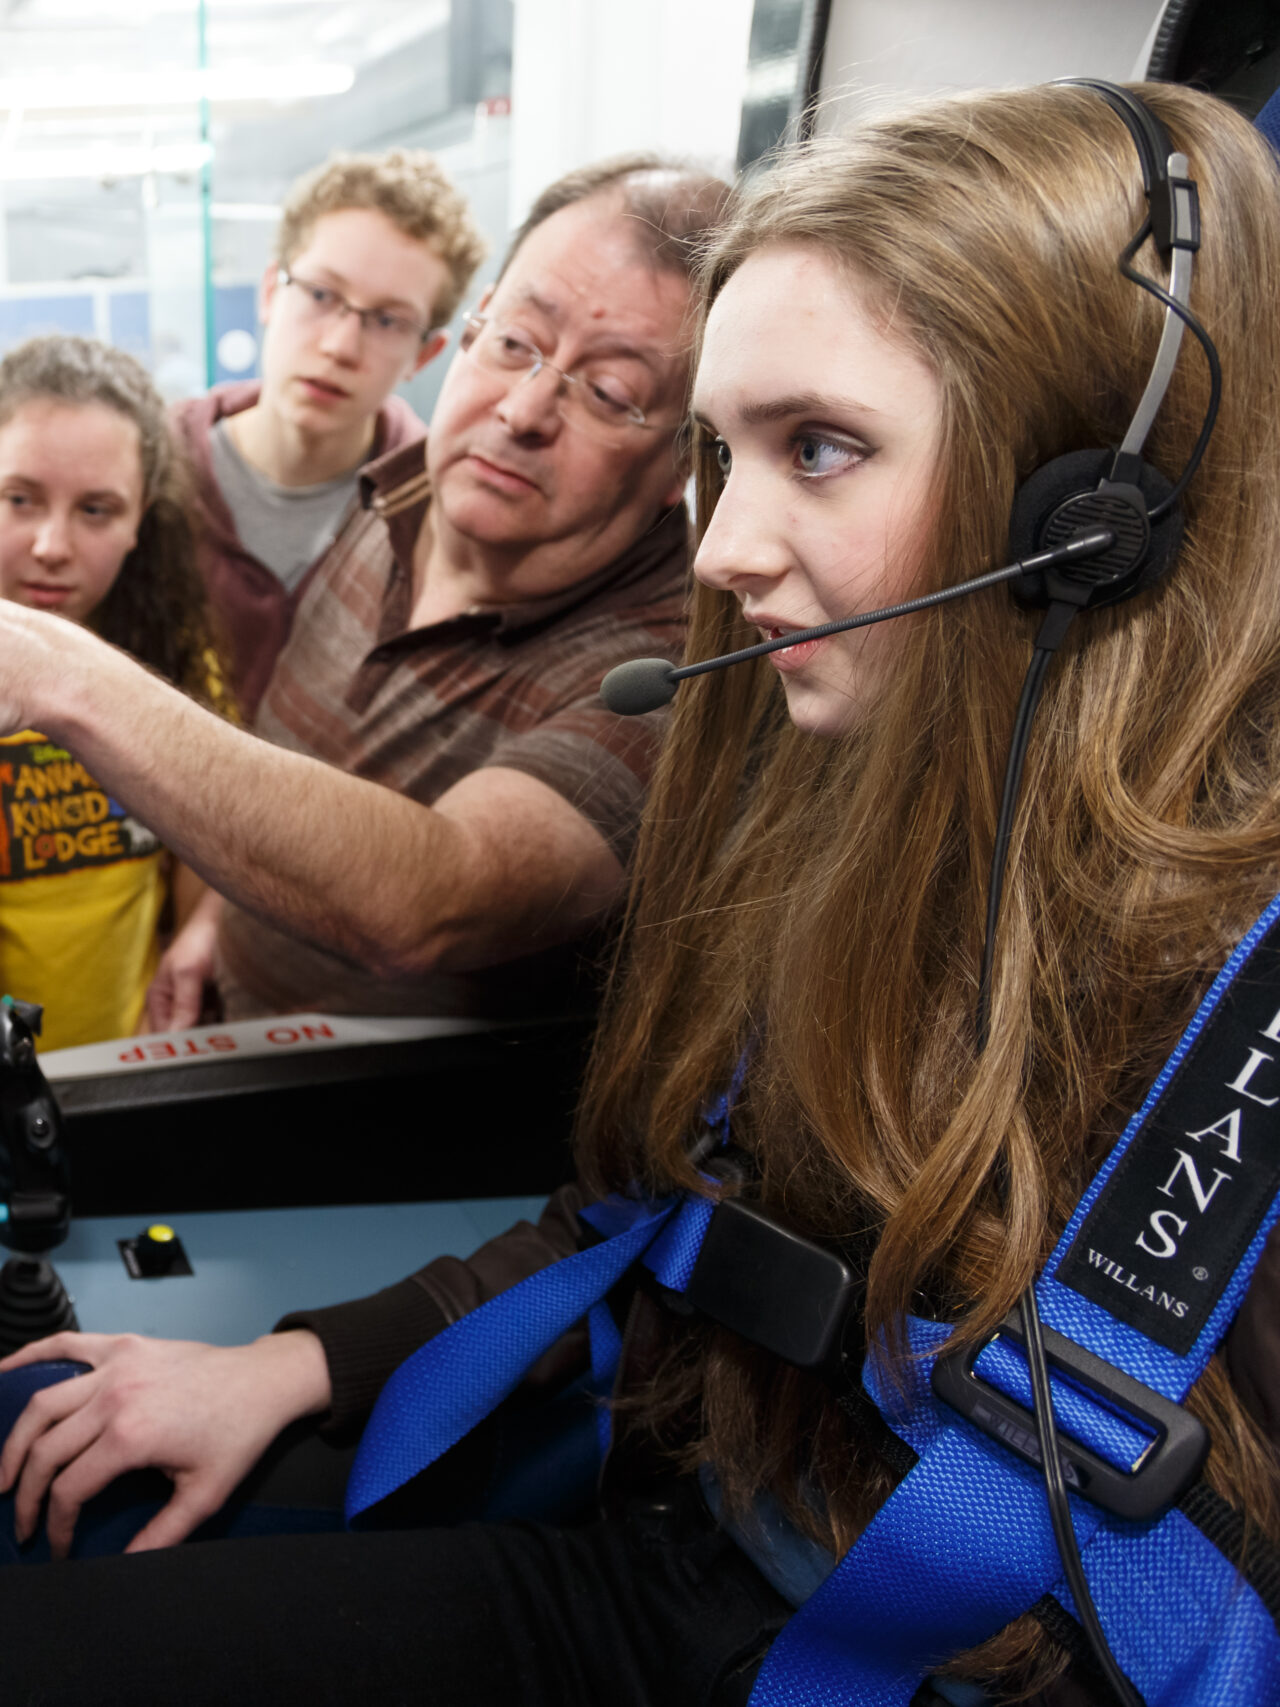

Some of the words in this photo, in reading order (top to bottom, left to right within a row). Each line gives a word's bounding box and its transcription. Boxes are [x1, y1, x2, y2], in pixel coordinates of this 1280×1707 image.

[10, 791, 110, 838] KINGD
[22, 820, 124, 870] LODGE
[119, 1034, 238, 1064] STEP
[266, 1023, 335, 1045] NO
[1087, 1247, 1190, 1319] WILLANS
[988, 1411, 1075, 1480] WILLS
